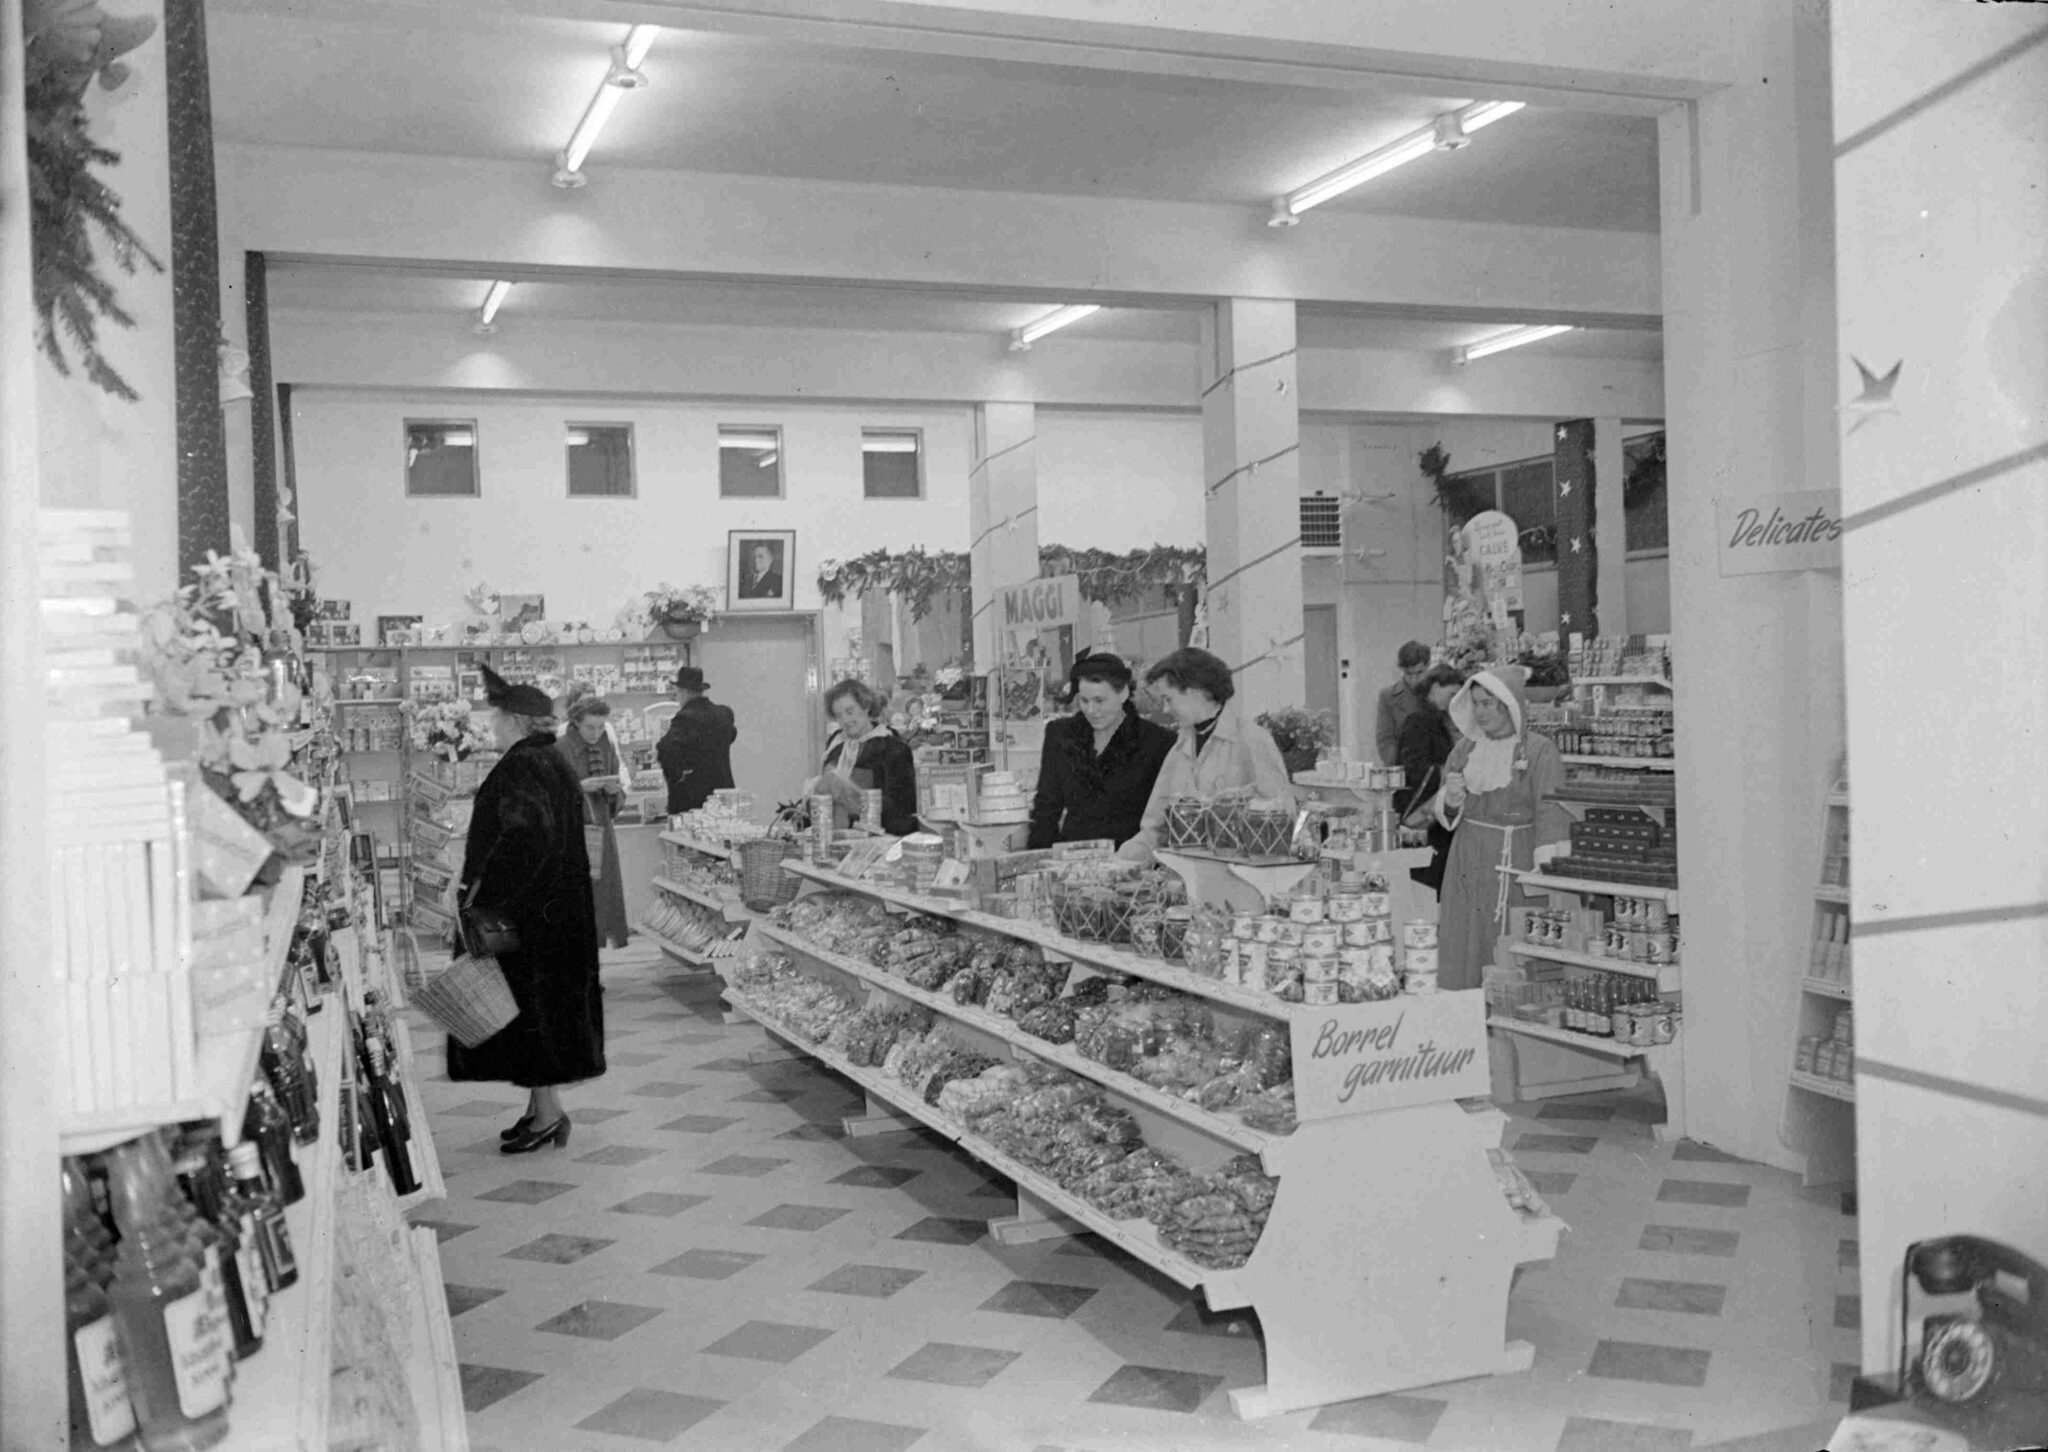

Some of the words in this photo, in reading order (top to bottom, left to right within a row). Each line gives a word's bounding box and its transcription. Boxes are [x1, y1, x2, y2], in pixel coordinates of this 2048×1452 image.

[1728, 506, 1842, 548] Delicates
[1004, 581, 1064, 625] MAGGI
[1311, 1009, 1406, 1060] Borrel
[1337, 1039, 1476, 1104] garnituur
